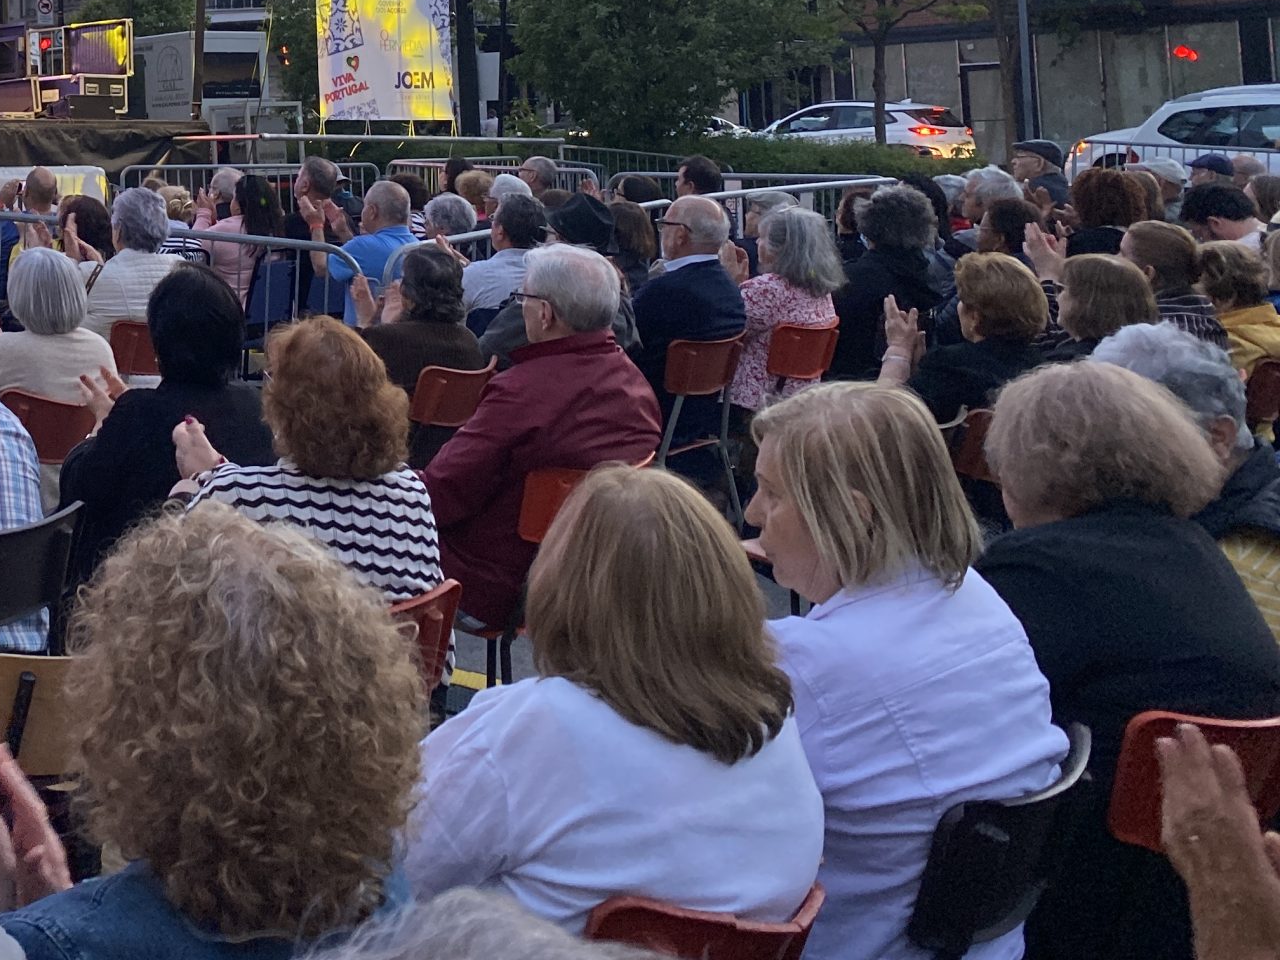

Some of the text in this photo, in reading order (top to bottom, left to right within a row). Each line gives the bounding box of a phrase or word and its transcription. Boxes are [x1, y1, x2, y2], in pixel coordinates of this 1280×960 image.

[331, 72, 356, 88] VIVA
[394, 71, 435, 90] JOEM
[324, 81, 370, 104] PORTUGAL
